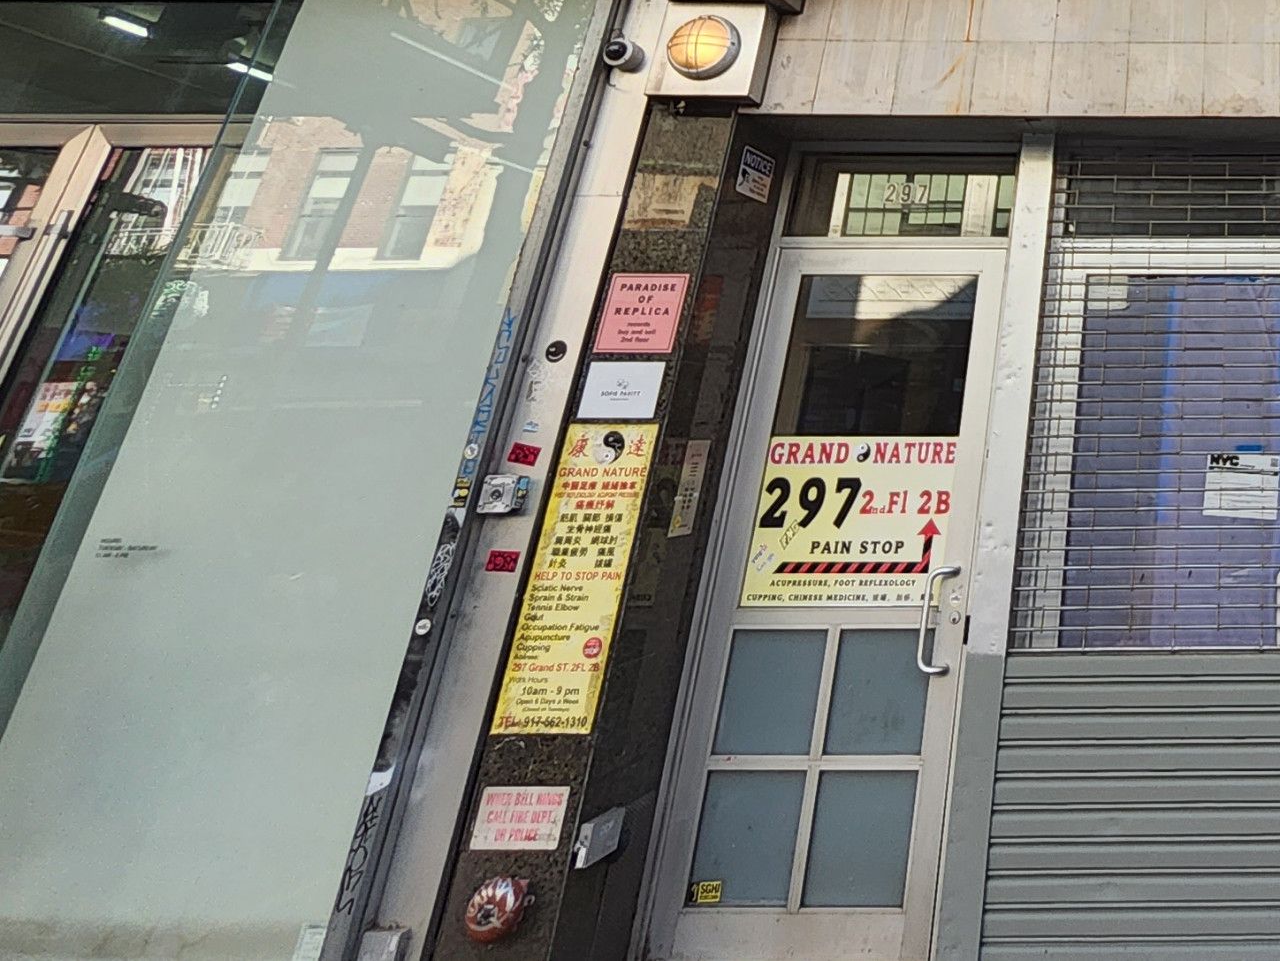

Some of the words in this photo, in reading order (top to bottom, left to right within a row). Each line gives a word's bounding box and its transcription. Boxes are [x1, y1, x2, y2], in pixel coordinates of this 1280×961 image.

[744, 151, 772, 175] NOTICE
[885, 183, 928, 203] 297
[620, 283, 677, 292] PARADISE
[638, 295, 653, 304] OF
[614, 307, 670, 316] REPLICA
[770, 441, 850, 464] GRAND
[872, 441, 958, 464] NATURE
[1210, 454, 1240, 467] NYC
[559, 466, 599, 478] GRAND
[602, 466, 647, 478] NATURE
[758, 476, 862, 530] 297
[917, 489, 951, 515] 2B
[809, 540, 855, 555] PAIN
[859, 540, 905, 555] STOP
[534, 571, 558, 581] HELP
[560, 571, 573, 581] TO
[575, 571, 599, 581] STOP
[601, 571, 622, 581] PAIN
[560, 584, 584, 592] Nerve
[834, 579, 855, 587] FOOT
[528, 594, 555, 602] Sprain
[527, 603, 553, 611] Tennis
[555, 603, 580, 611] Elbow
[521, 623, 567, 632] Occupation
[569, 623, 600, 633] Fatigue
[516, 643, 551, 653] Cupping
[528, 663, 555, 672] Grand
[528, 676, 549, 684] Hours
[521, 686, 548, 696] 10am
[563, 687, 580, 697] pm
[514, 792, 533, 806] BELL
[487, 810, 506, 824] CALL
[510, 810, 529, 824] FIRE
[494, 828, 506, 841] OR
[508, 828, 540, 842] POLICE
